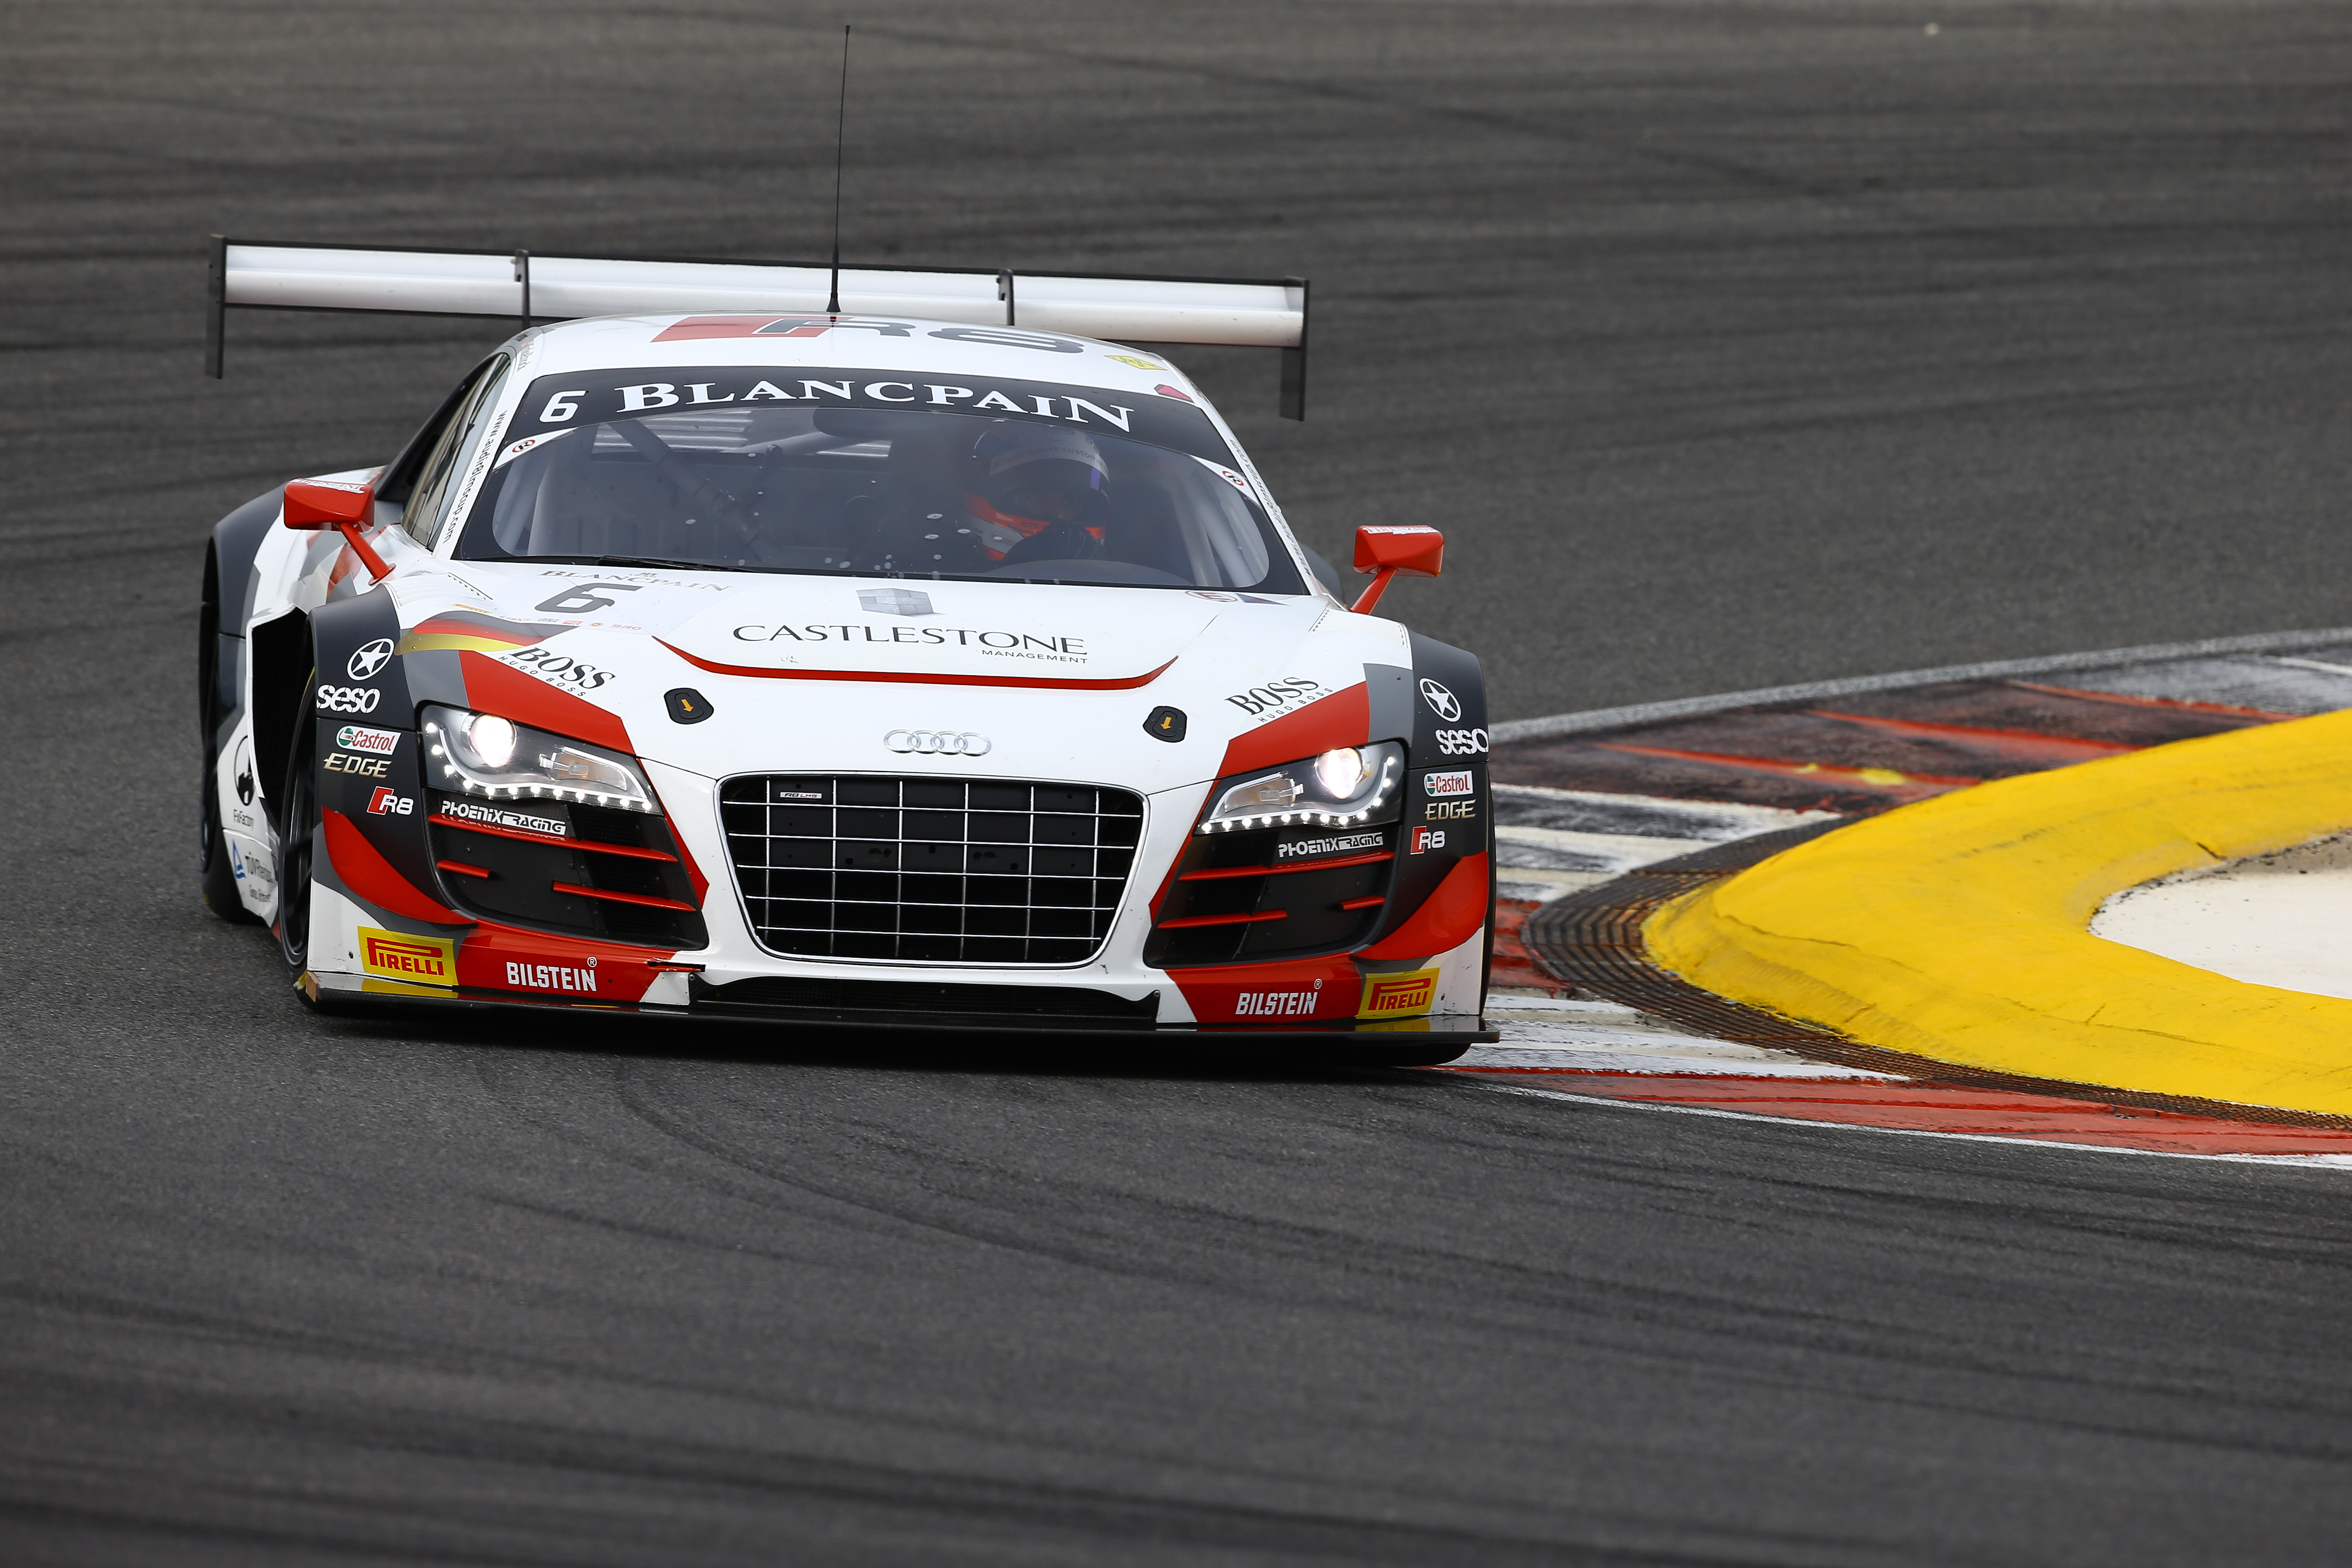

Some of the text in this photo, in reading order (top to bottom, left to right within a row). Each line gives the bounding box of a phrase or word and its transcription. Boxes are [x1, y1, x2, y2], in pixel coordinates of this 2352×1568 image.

[753, 317, 1084, 353] R8
[539, 380, 1134, 432] 6 BLANCPAIN
[536, 571, 733, 591] BLANCPAIN
[534, 583, 644, 613] 6
[733, 624, 1088, 656] CASTLESTONE
[508, 647, 616, 689] BOSS
[982, 650, 1088, 664] MANAGEMENT
[498, 656, 586, 697] HUGO BOSS
[317, 685, 381, 714] seso
[1224, 677, 1319, 715] BOSS
[1258, 688, 1333, 723] HUGO BOSS
[352, 730, 396, 751] Castrol
[1435, 728, 1489, 755] seso
[323, 753, 392, 779] EDGE
[1436, 774, 1470, 793] Castrol
[377, 794, 414, 815] R8
[1425, 799, 1476, 821] EDGE
[1418, 831, 1446, 850] R8
[367, 937, 444, 976] PIRELLI
[506, 961, 597, 992] BILSTEIN
[1235, 992, 1318, 1015] BILSTEIN
[1368, 978, 1431, 1011] PIRELLI
